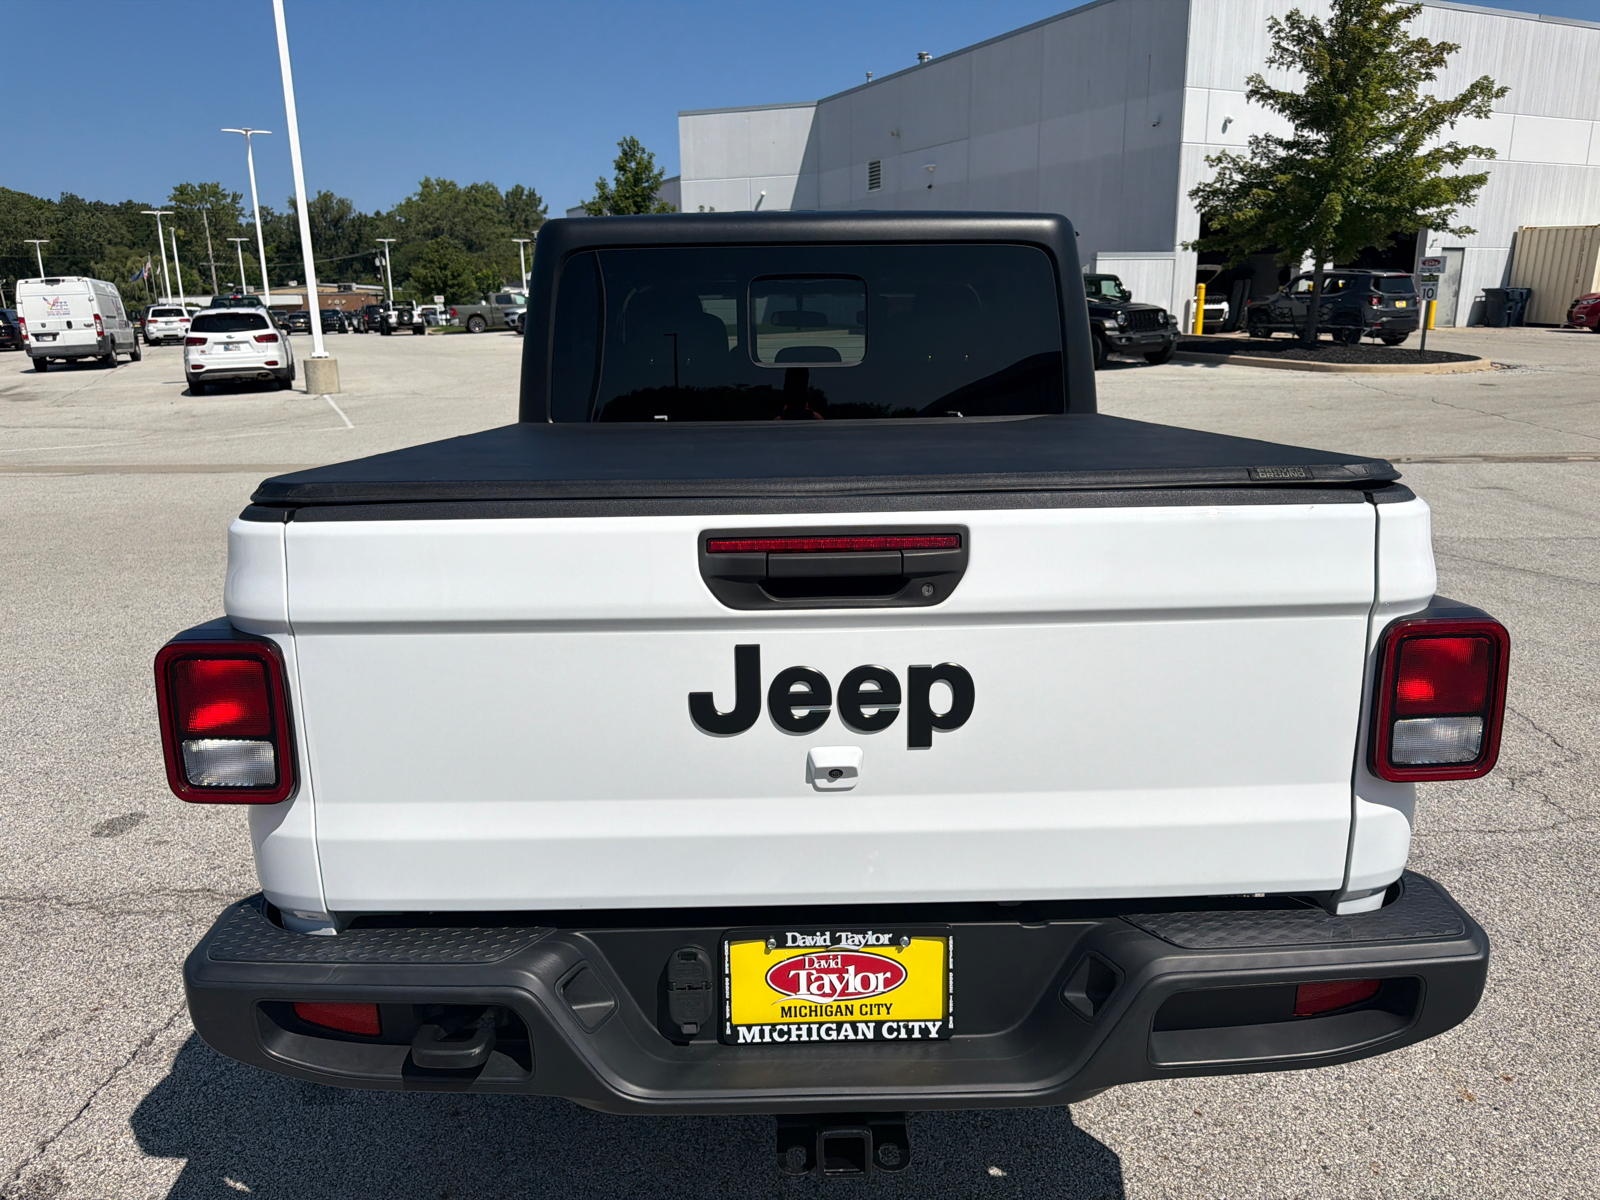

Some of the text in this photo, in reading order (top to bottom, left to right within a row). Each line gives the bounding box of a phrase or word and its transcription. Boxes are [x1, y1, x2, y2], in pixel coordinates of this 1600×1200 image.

[1422, 288, 1434, 299] 10
[688, 644, 975, 750] Jeep
[785, 930, 892, 949] David Taylor
[804, 955, 842, 969] David
[788, 967, 891, 1001] Taylor
[780, 1002, 893, 1018] MICHIGAN CITY
[736, 1021, 943, 1043] MICHIGAN CITY
